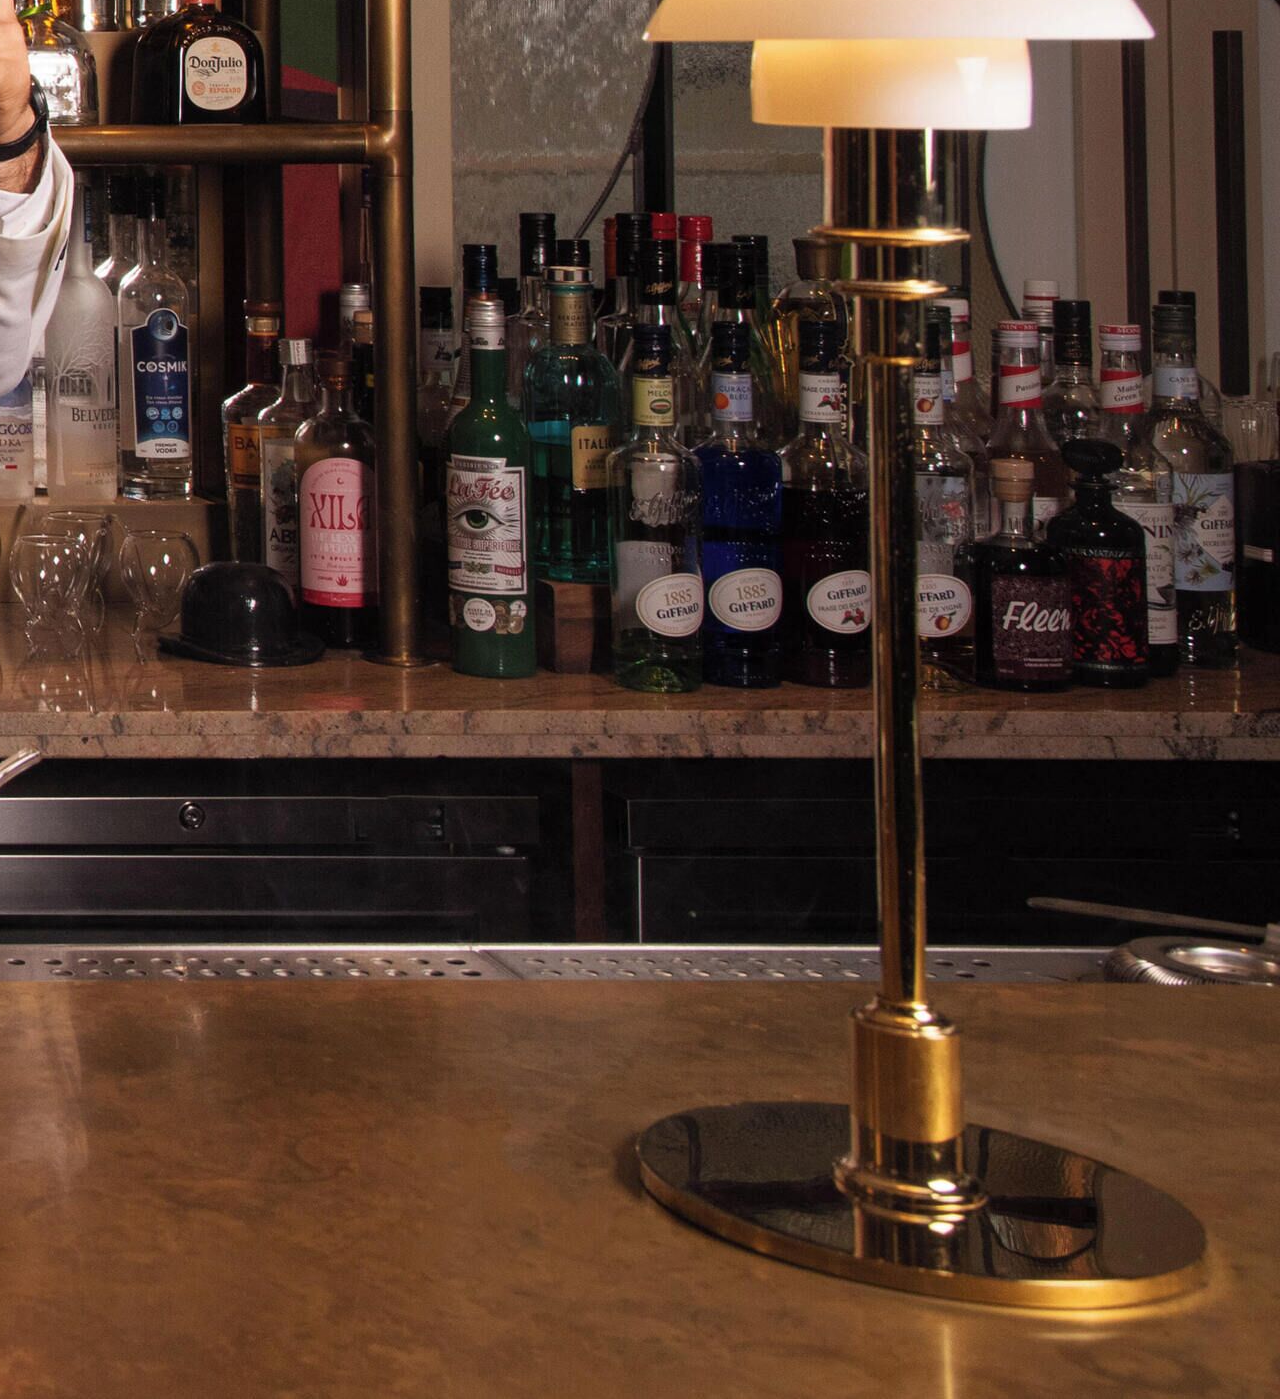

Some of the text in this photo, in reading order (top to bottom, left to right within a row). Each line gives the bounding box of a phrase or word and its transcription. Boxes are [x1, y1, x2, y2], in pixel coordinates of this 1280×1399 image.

[189, 56, 243, 73] Don Julio
[137, 361, 187, 373] COSMIK
[664, 589, 693, 606] 1885
[736, 584, 766, 600] 1885
[941, 603, 962, 612] VIGNE
